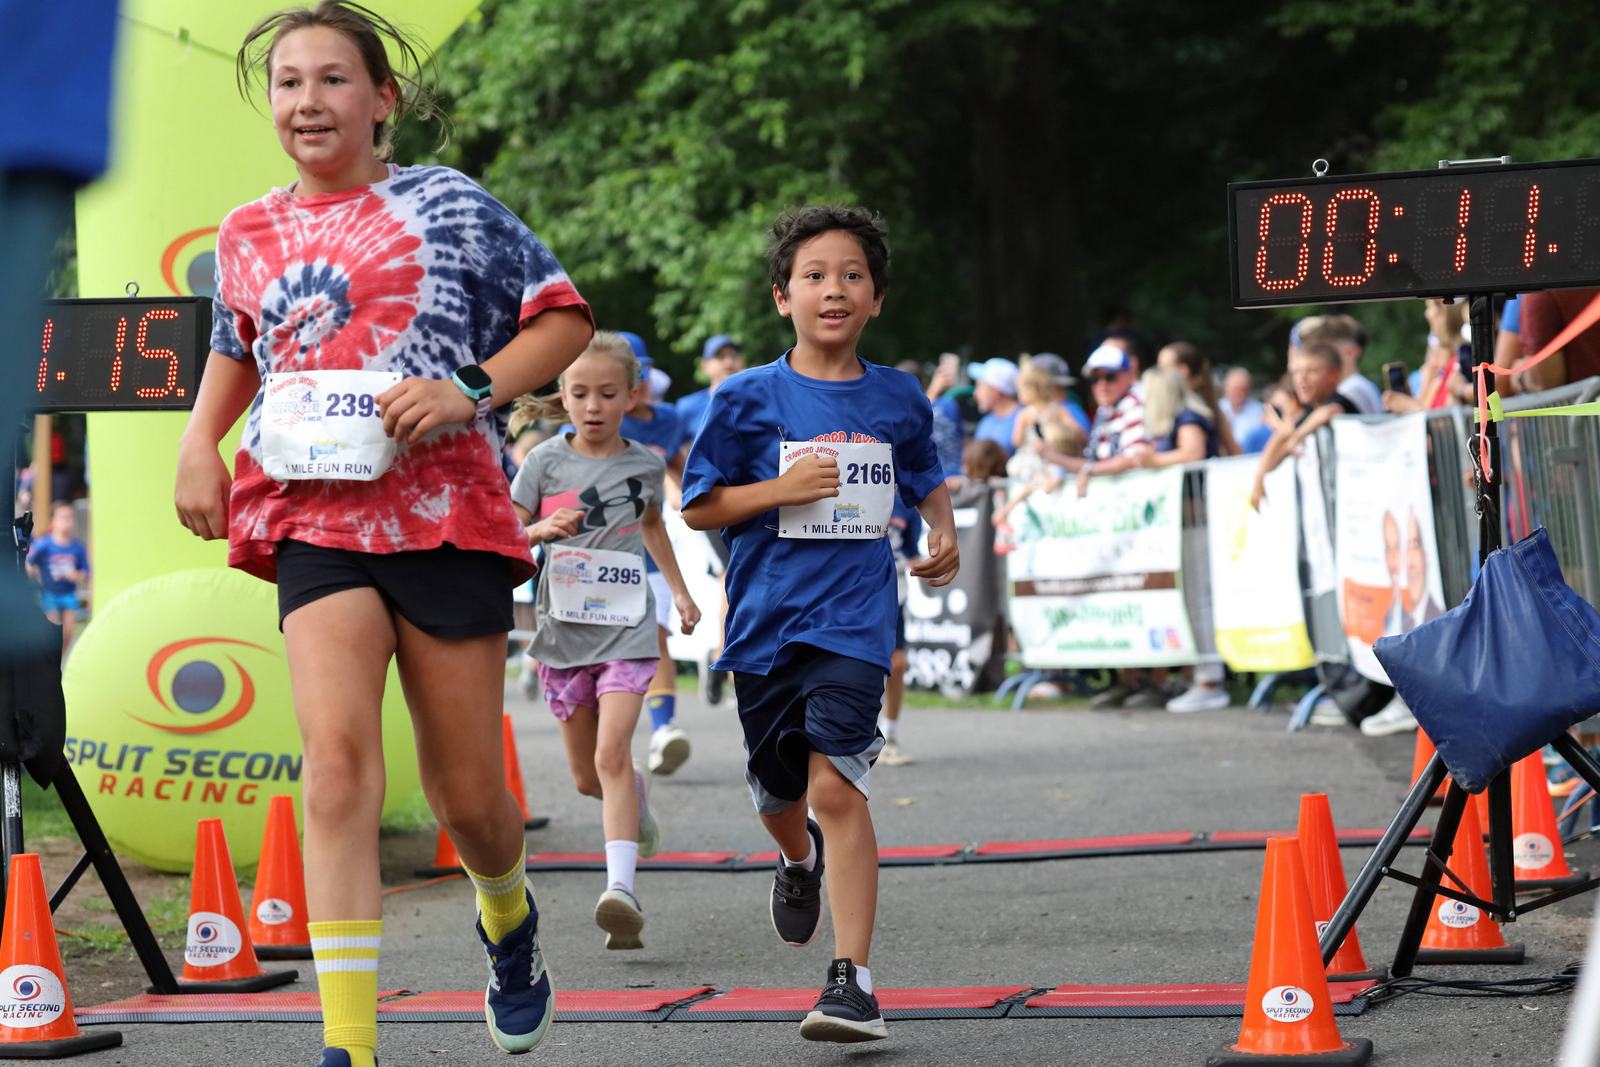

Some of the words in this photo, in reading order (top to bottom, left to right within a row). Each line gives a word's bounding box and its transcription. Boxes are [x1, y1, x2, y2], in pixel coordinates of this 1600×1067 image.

[326, 393, 382, 417] 239
[784, 446, 814, 463] CRANFORD
[815, 446, 839, 458] JAYCEES
[292, 464, 313, 474] MILE
[317, 463, 340, 473] FUN
[344, 464, 372, 475] RUN
[846, 462, 891, 485] 2166
[802, 525, 807, 533] 1
[812, 525, 838, 533] MILE
[841, 525, 862, 533] FUN
[597, 566, 641, 585] 2395
[565, 611, 587, 620] MILE
[589, 612, 608, 621] FUN
[610, 614, 629, 622] RUN
[65, 737, 153, 772] SPLIT
[164, 749, 303, 782] SECON
[99, 774, 259, 805] RACING
[199, 945, 235, 953] SECOND
[0, 1004, 17, 1012] PLIT
[19, 1003, 60, 1013] SECOND
[3, 1011, 43, 1019] RACING
